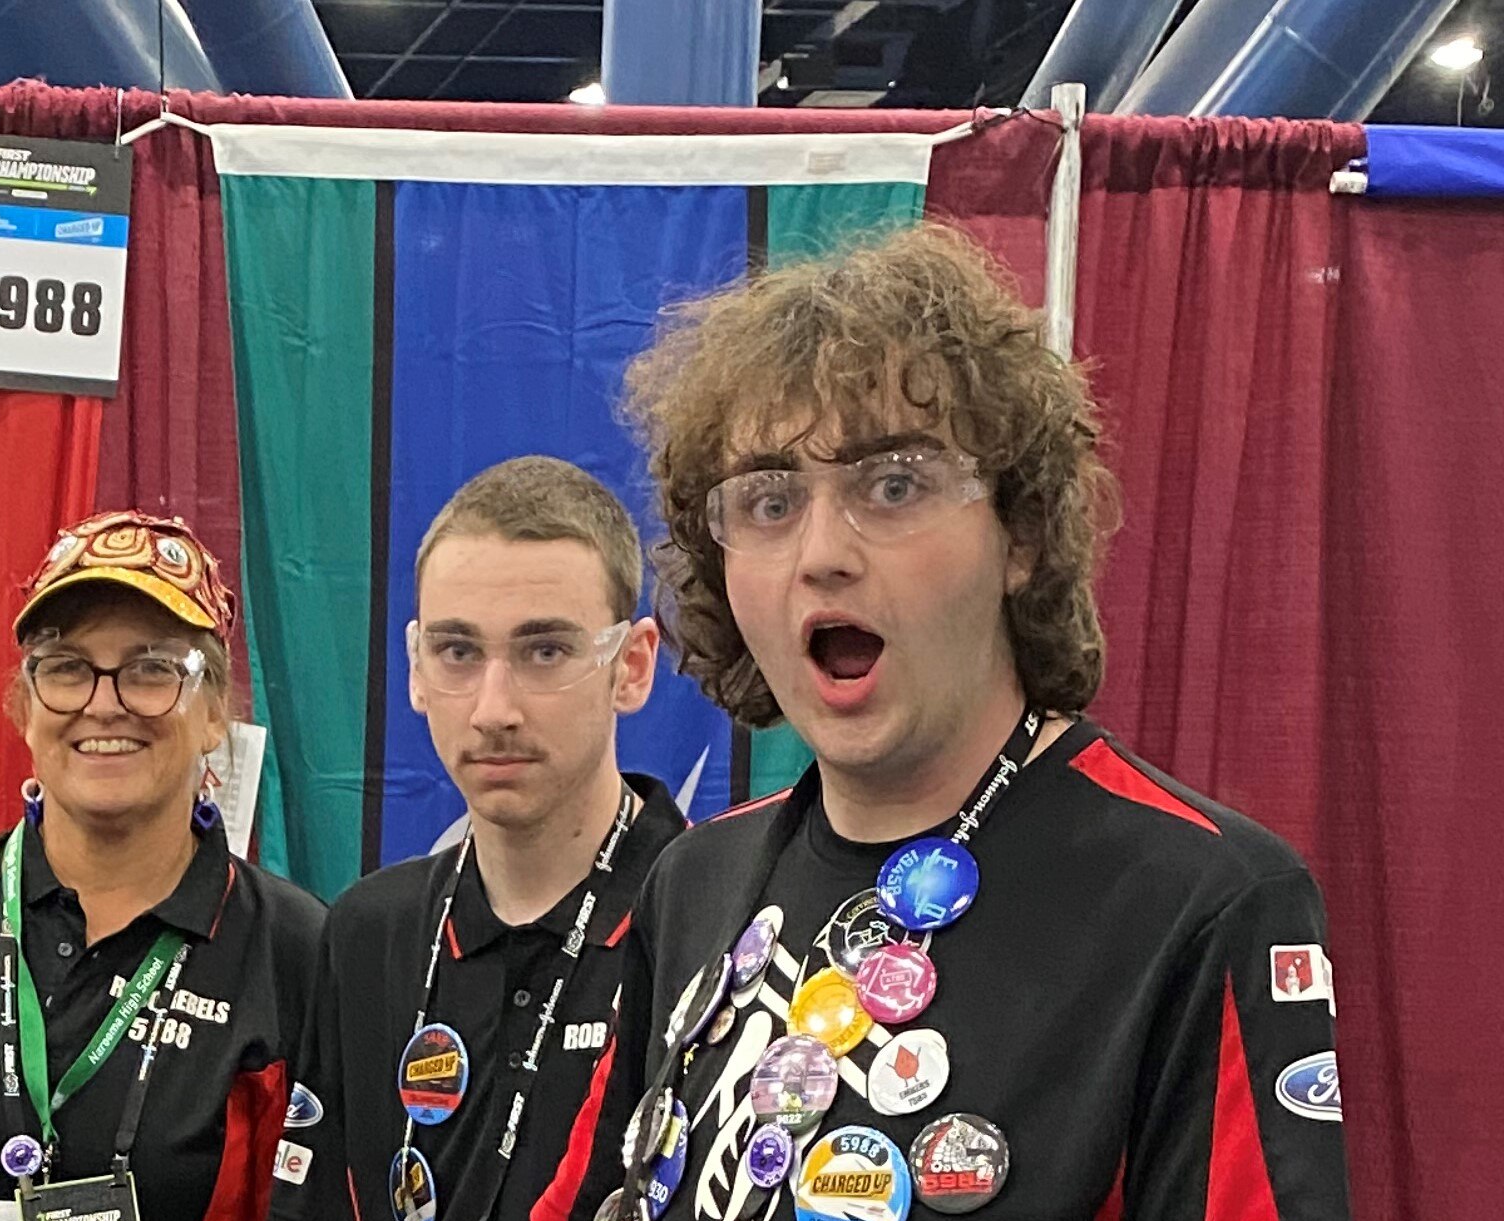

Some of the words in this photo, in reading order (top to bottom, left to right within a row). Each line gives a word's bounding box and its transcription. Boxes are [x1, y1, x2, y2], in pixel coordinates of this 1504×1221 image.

[88, 1017, 124, 1065] Narooma
[118, 991, 142, 1018] High
[136, 957, 165, 993] School
[128, 1016, 192, 1050] 588
[839, 1136, 880, 1159] 5988
[812, 1174, 870, 1194] CHARGED
[873, 1173, 892, 1190] UP
